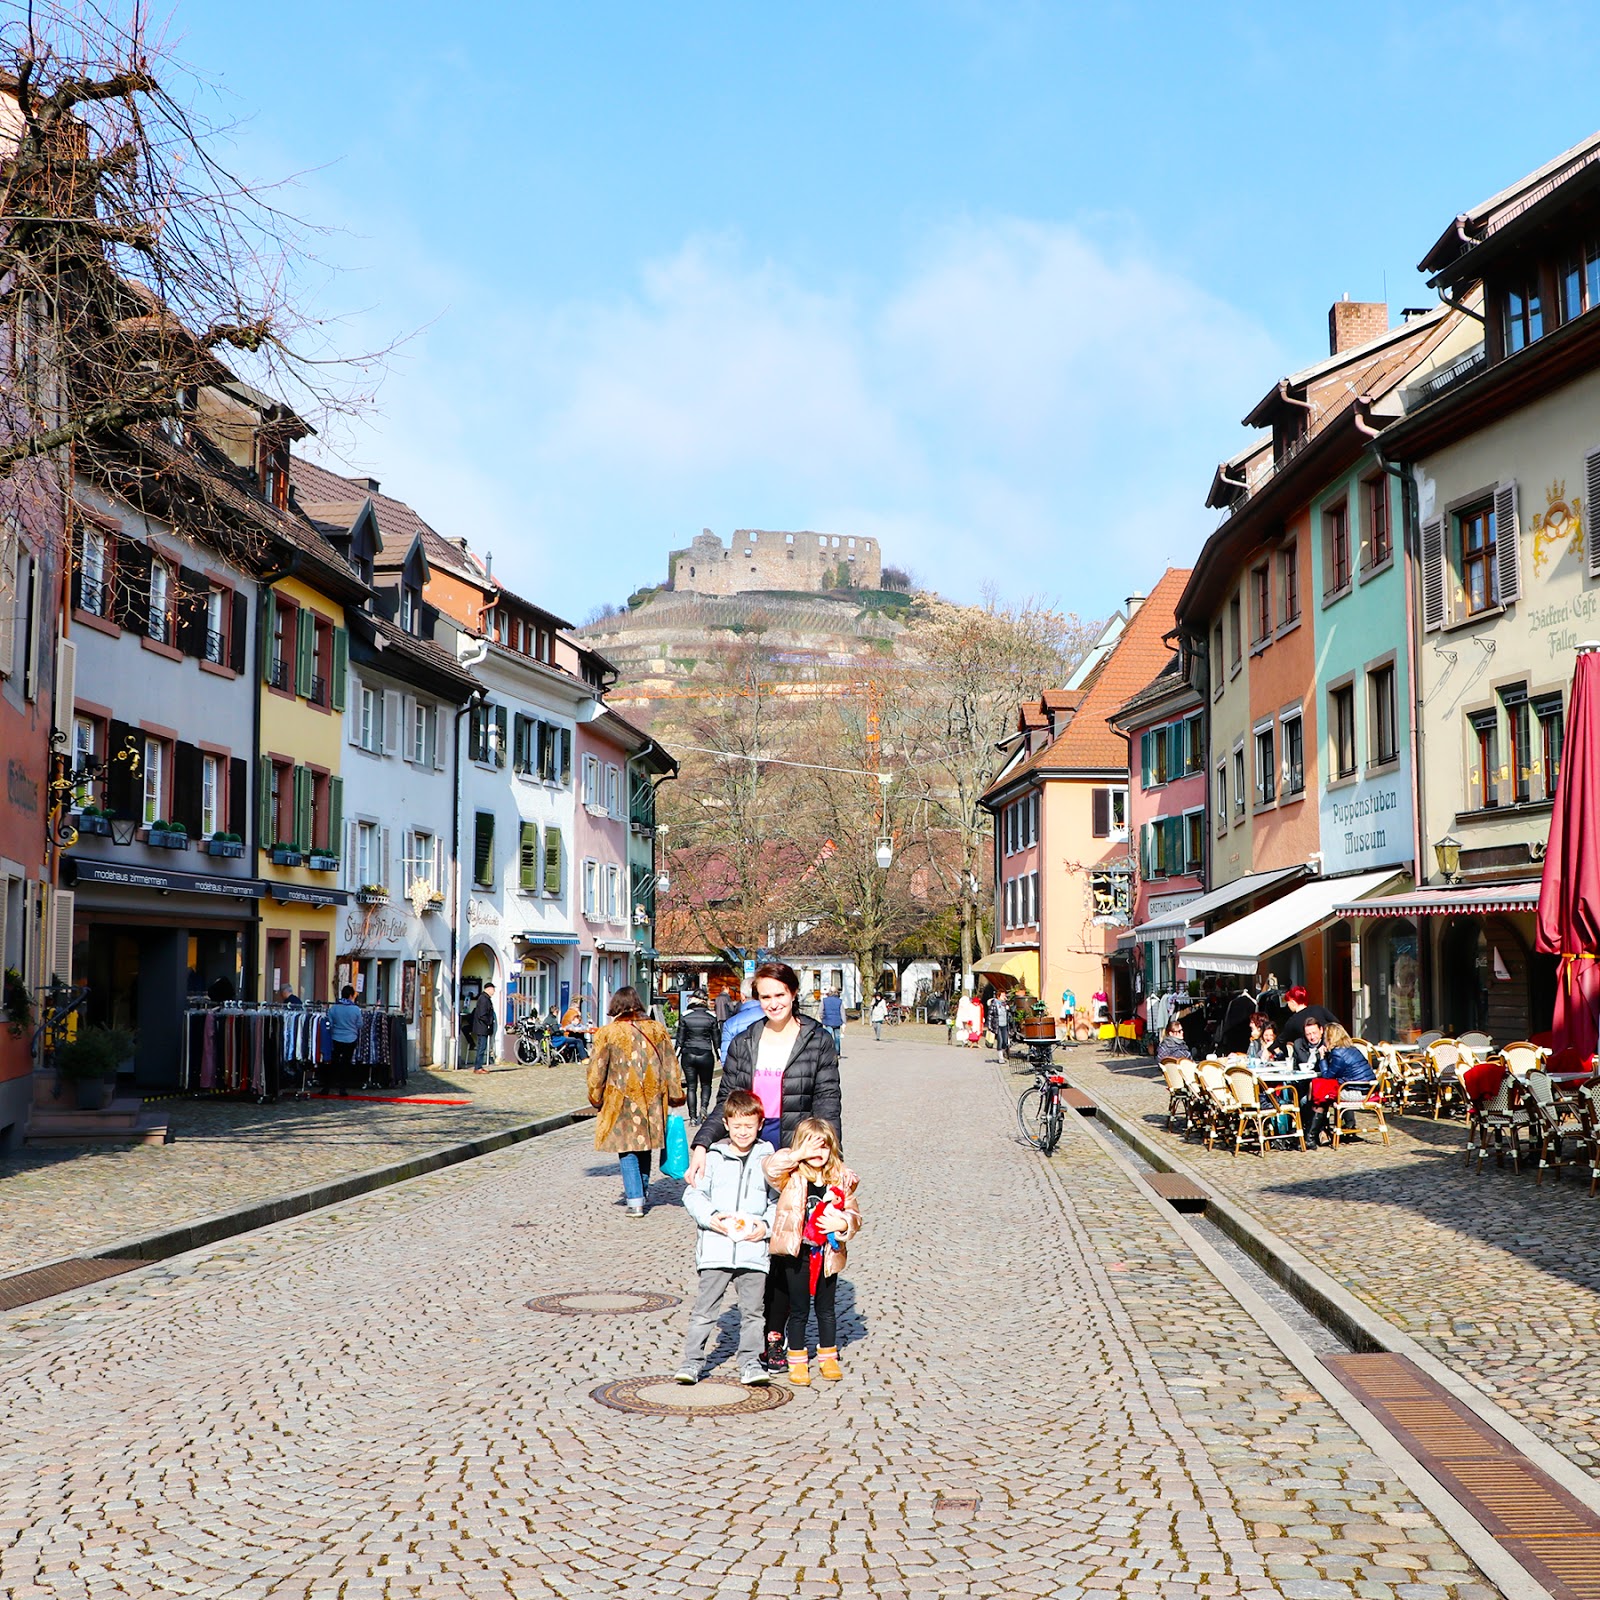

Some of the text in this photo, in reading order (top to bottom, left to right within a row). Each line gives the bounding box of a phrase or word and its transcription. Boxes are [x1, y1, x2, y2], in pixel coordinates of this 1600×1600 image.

[1547, 628, 1577, 660] Faller
[1333, 790, 1397, 826] Puppenstuben
[1344, 829, 1386, 855] Museum
[94, 869, 167, 886] modehaus zimmermann
[195, 881, 254, 895] modehaus zimmermann
[288, 891, 334, 903] modehaus zimmermann
[1092, 915, 1120, 927] HOTEL
